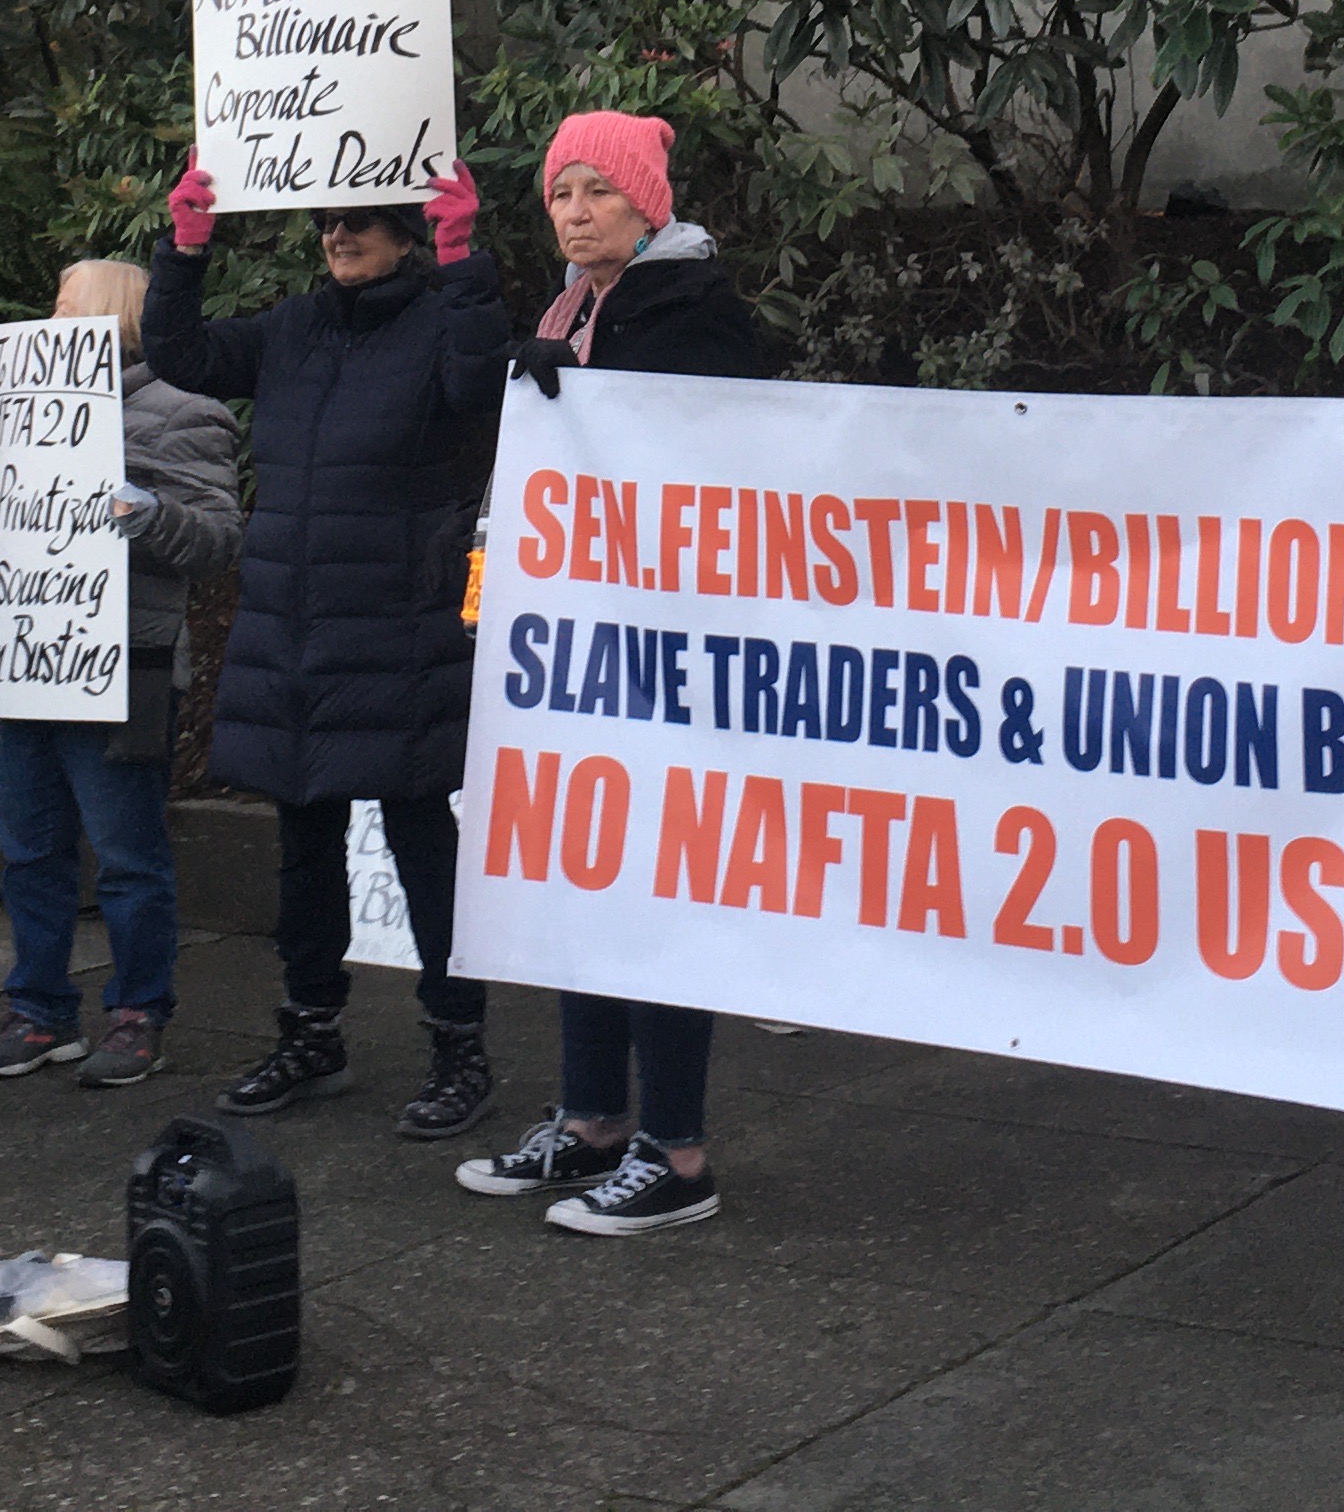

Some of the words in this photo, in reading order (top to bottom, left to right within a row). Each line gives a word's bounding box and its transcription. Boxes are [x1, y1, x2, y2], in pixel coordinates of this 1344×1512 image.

[235, 6, 421, 61] Billionaire
[203, 65, 343, 139] Corporate
[243, 130, 319, 192] Trade
[327, 117, 445, 192] Deals
[10, 324, 117, 395] USMCA
[35, 400, 91, 449] 2.0
[9, 614, 122, 697] Busting
[504, 612, 692, 725] SLAVE
[703, 634, 983, 758] TRADERS
[998, 675, 1045, 766] &
[1062, 666, 1279, 790] UNION
[483, 746, 632, 892] NO
[651, 765, 968, 940] NAFTA
[992, 804, 1158, 967] 2.0
